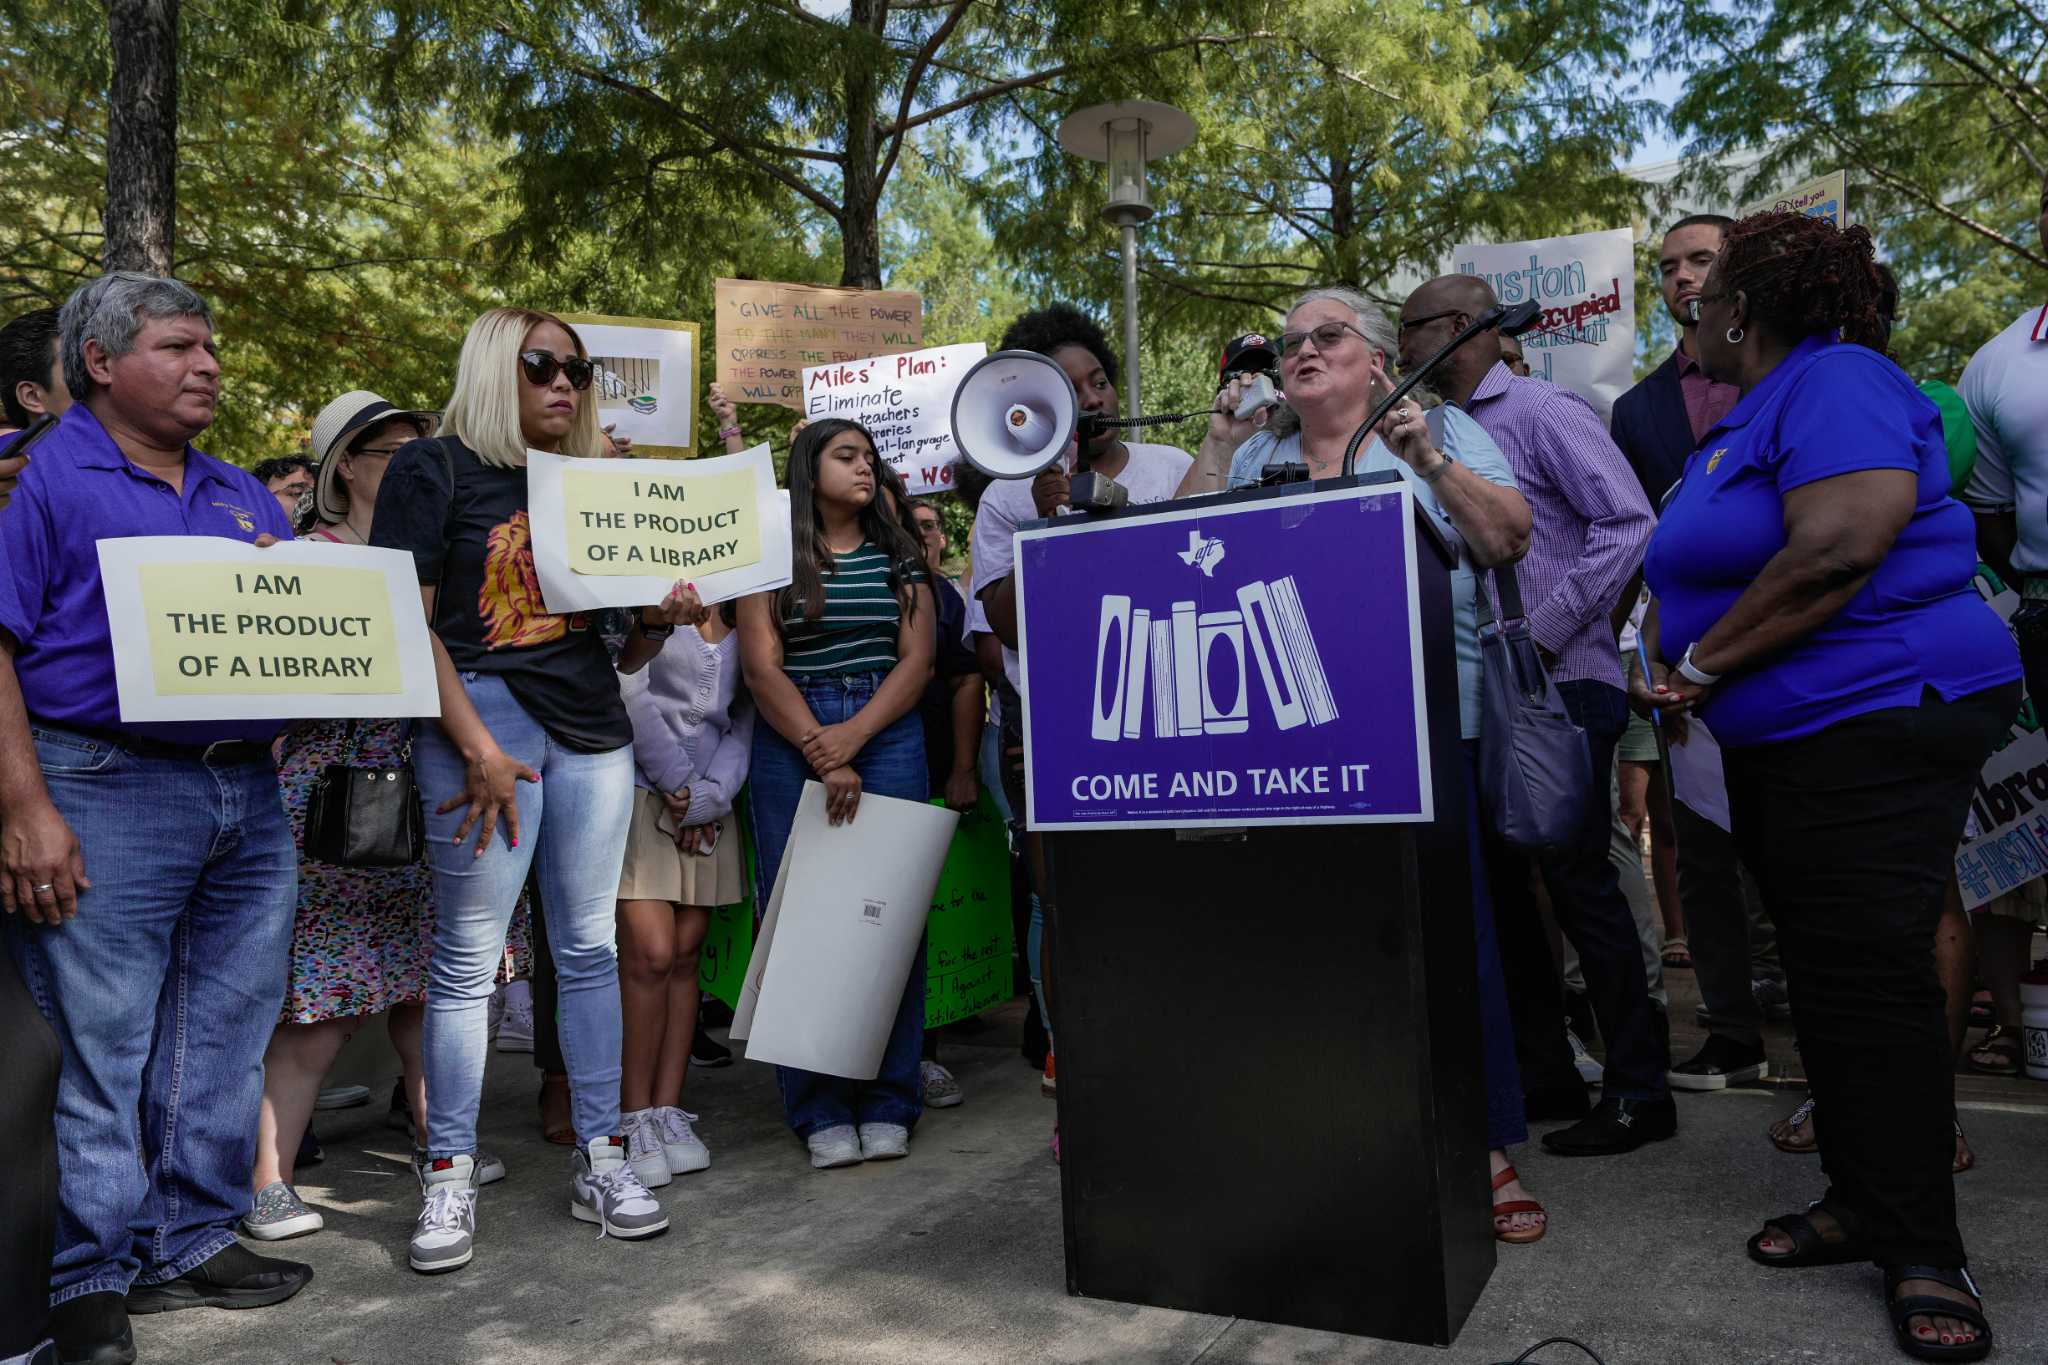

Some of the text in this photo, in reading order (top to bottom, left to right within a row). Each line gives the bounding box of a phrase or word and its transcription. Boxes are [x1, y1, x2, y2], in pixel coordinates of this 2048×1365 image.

[1461, 255, 1586, 302] uston
[793, 304, 823, 321] ALL
[828, 304, 862, 320] THE
[870, 307, 912, 327] POWER
[1526, 278, 1621, 331] ccupied
[735, 328, 752, 342] TO
[763, 328, 793, 343] THE
[841, 330, 876, 343] THEY
[882, 332, 917, 345] WILL
[800, 350, 825, 362] THE
[832, 351, 857, 362] FEW
[896, 356, 946, 379] Plan:
[730, 367, 797, 380] THE POWER
[742, 385, 776, 398] WILL
[809, 385, 903, 415] Eliminate
[859, 406, 920, 425] teachers
[870, 425, 912, 439] braries
[876, 433, 951, 455] al-language
[633, 481, 685, 501] I AM
[580, 508, 740, 534] THE PRODUCT
[587, 539, 739, 567] OF A LIBRARY
[235, 573, 302, 595] I AM
[166, 612, 371, 637] THE PRODUCT
[178, 655, 373, 679] OF A LIBRARY
[1071, 764, 1370, 801] COME AND TAKE IT
